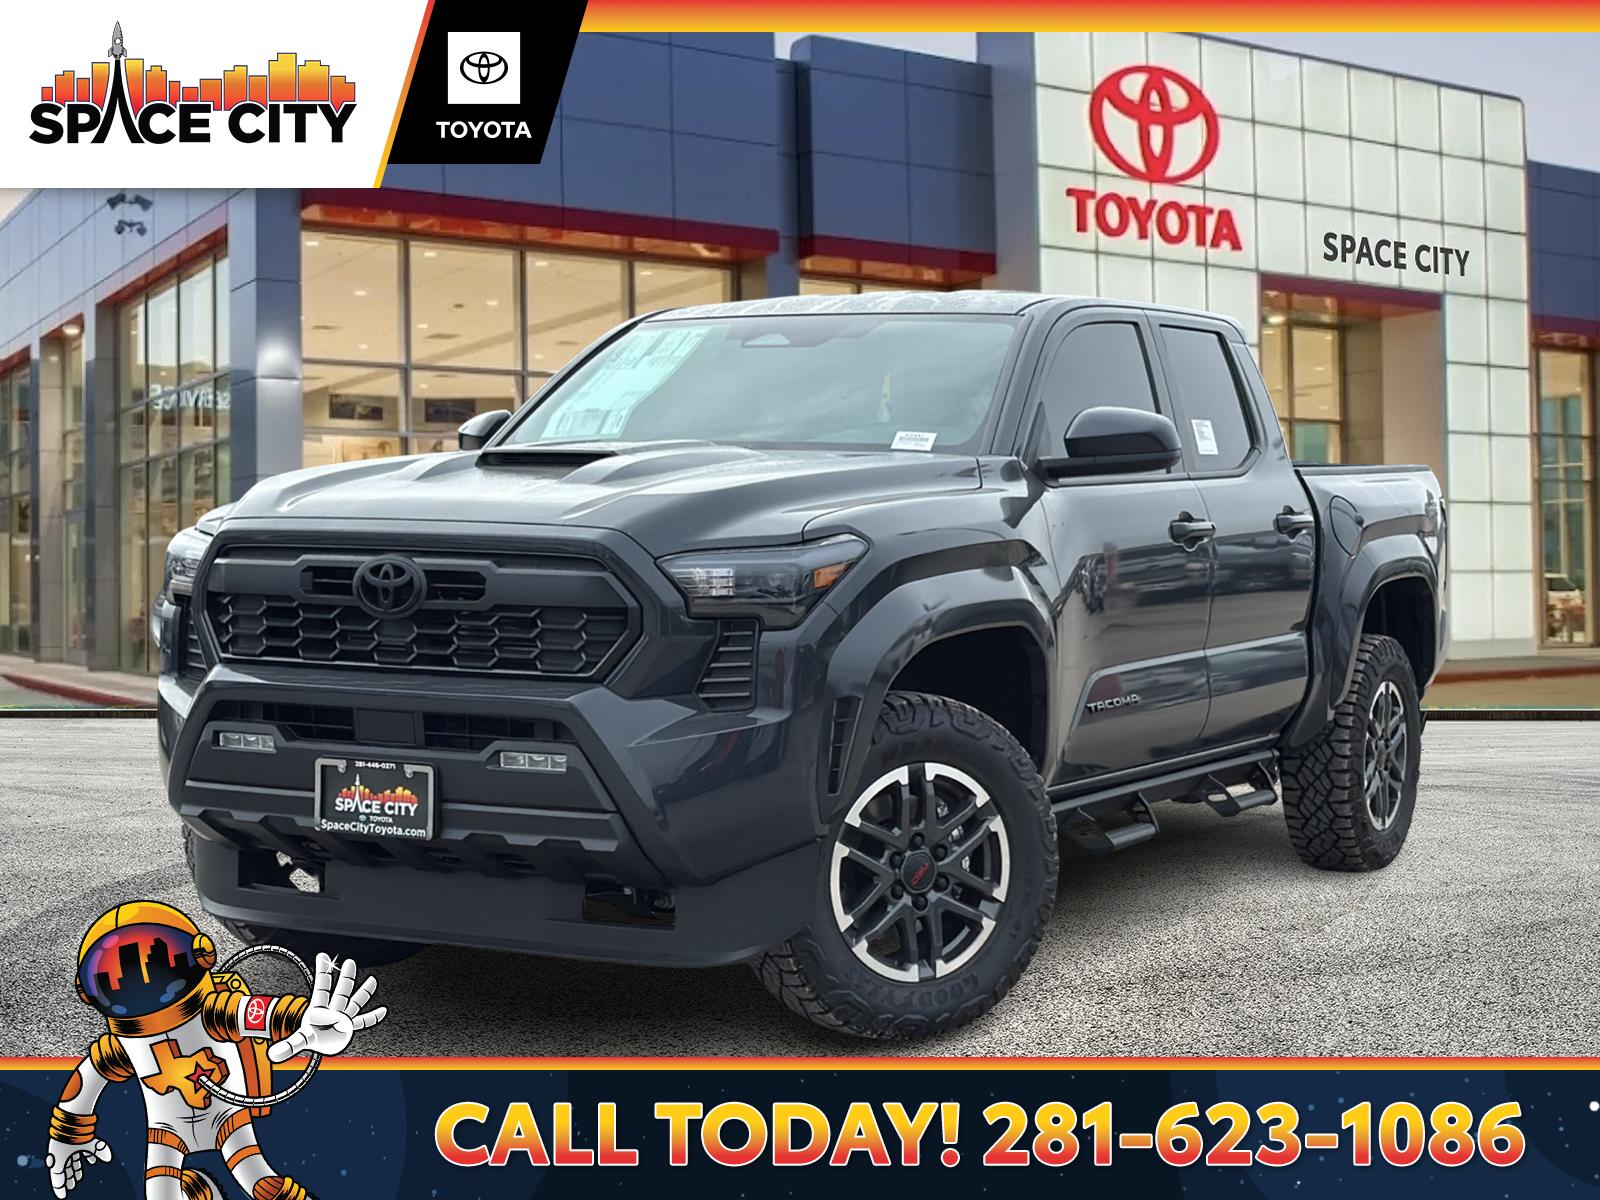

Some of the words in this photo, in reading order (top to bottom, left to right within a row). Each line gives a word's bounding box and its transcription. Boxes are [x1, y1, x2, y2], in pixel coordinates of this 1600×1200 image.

[1066, 188, 1242, 251] TOYOTA
[1323, 231, 1407, 270] SPACE
[1414, 245, 1470, 277] CITY
[1086, 693, 1140, 713] TACOMA
[335, 785, 381, 814] SPACE
[384, 801, 418, 817] CITY
[321, 819, 426, 837] SpaceCityToyota.com
[369, 815, 393, 823] TOYOTA
